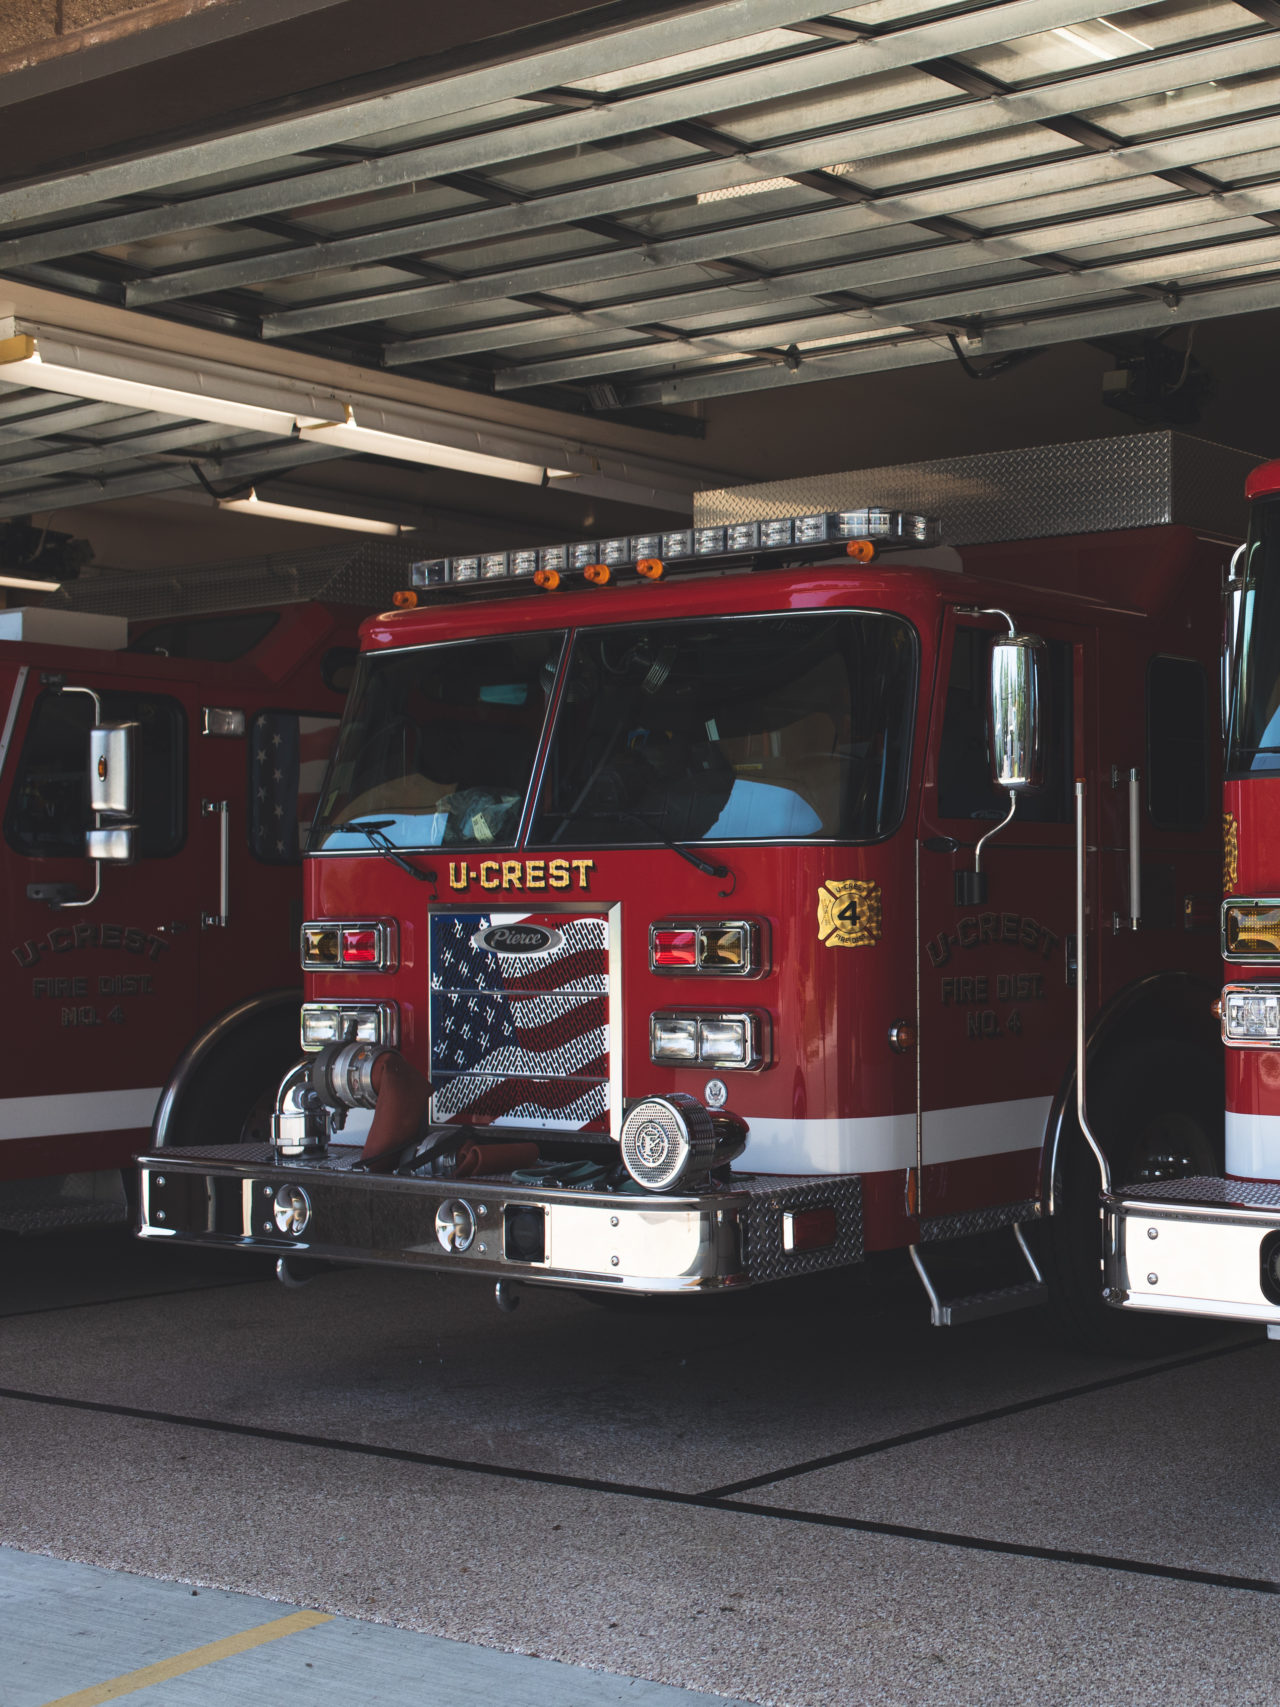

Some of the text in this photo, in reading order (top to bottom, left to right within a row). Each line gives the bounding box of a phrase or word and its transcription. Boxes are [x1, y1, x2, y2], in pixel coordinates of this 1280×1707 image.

[449, 858, 594, 890] U-CREST
[835, 883, 868, 893] U-CREST
[837, 900, 861, 926] 4
[11, 922, 170, 968] U-CREST
[490, 928, 543, 947] Pierce
[834, 933, 850, 944] FIRE
[925, 912, 1060, 968] U-CREST
[32, 975, 89, 998] FIRE
[941, 975, 988, 1004] FIRE
[107, 1003, 124, 1025] 4
[1006, 1008, 1023, 1035] 4
